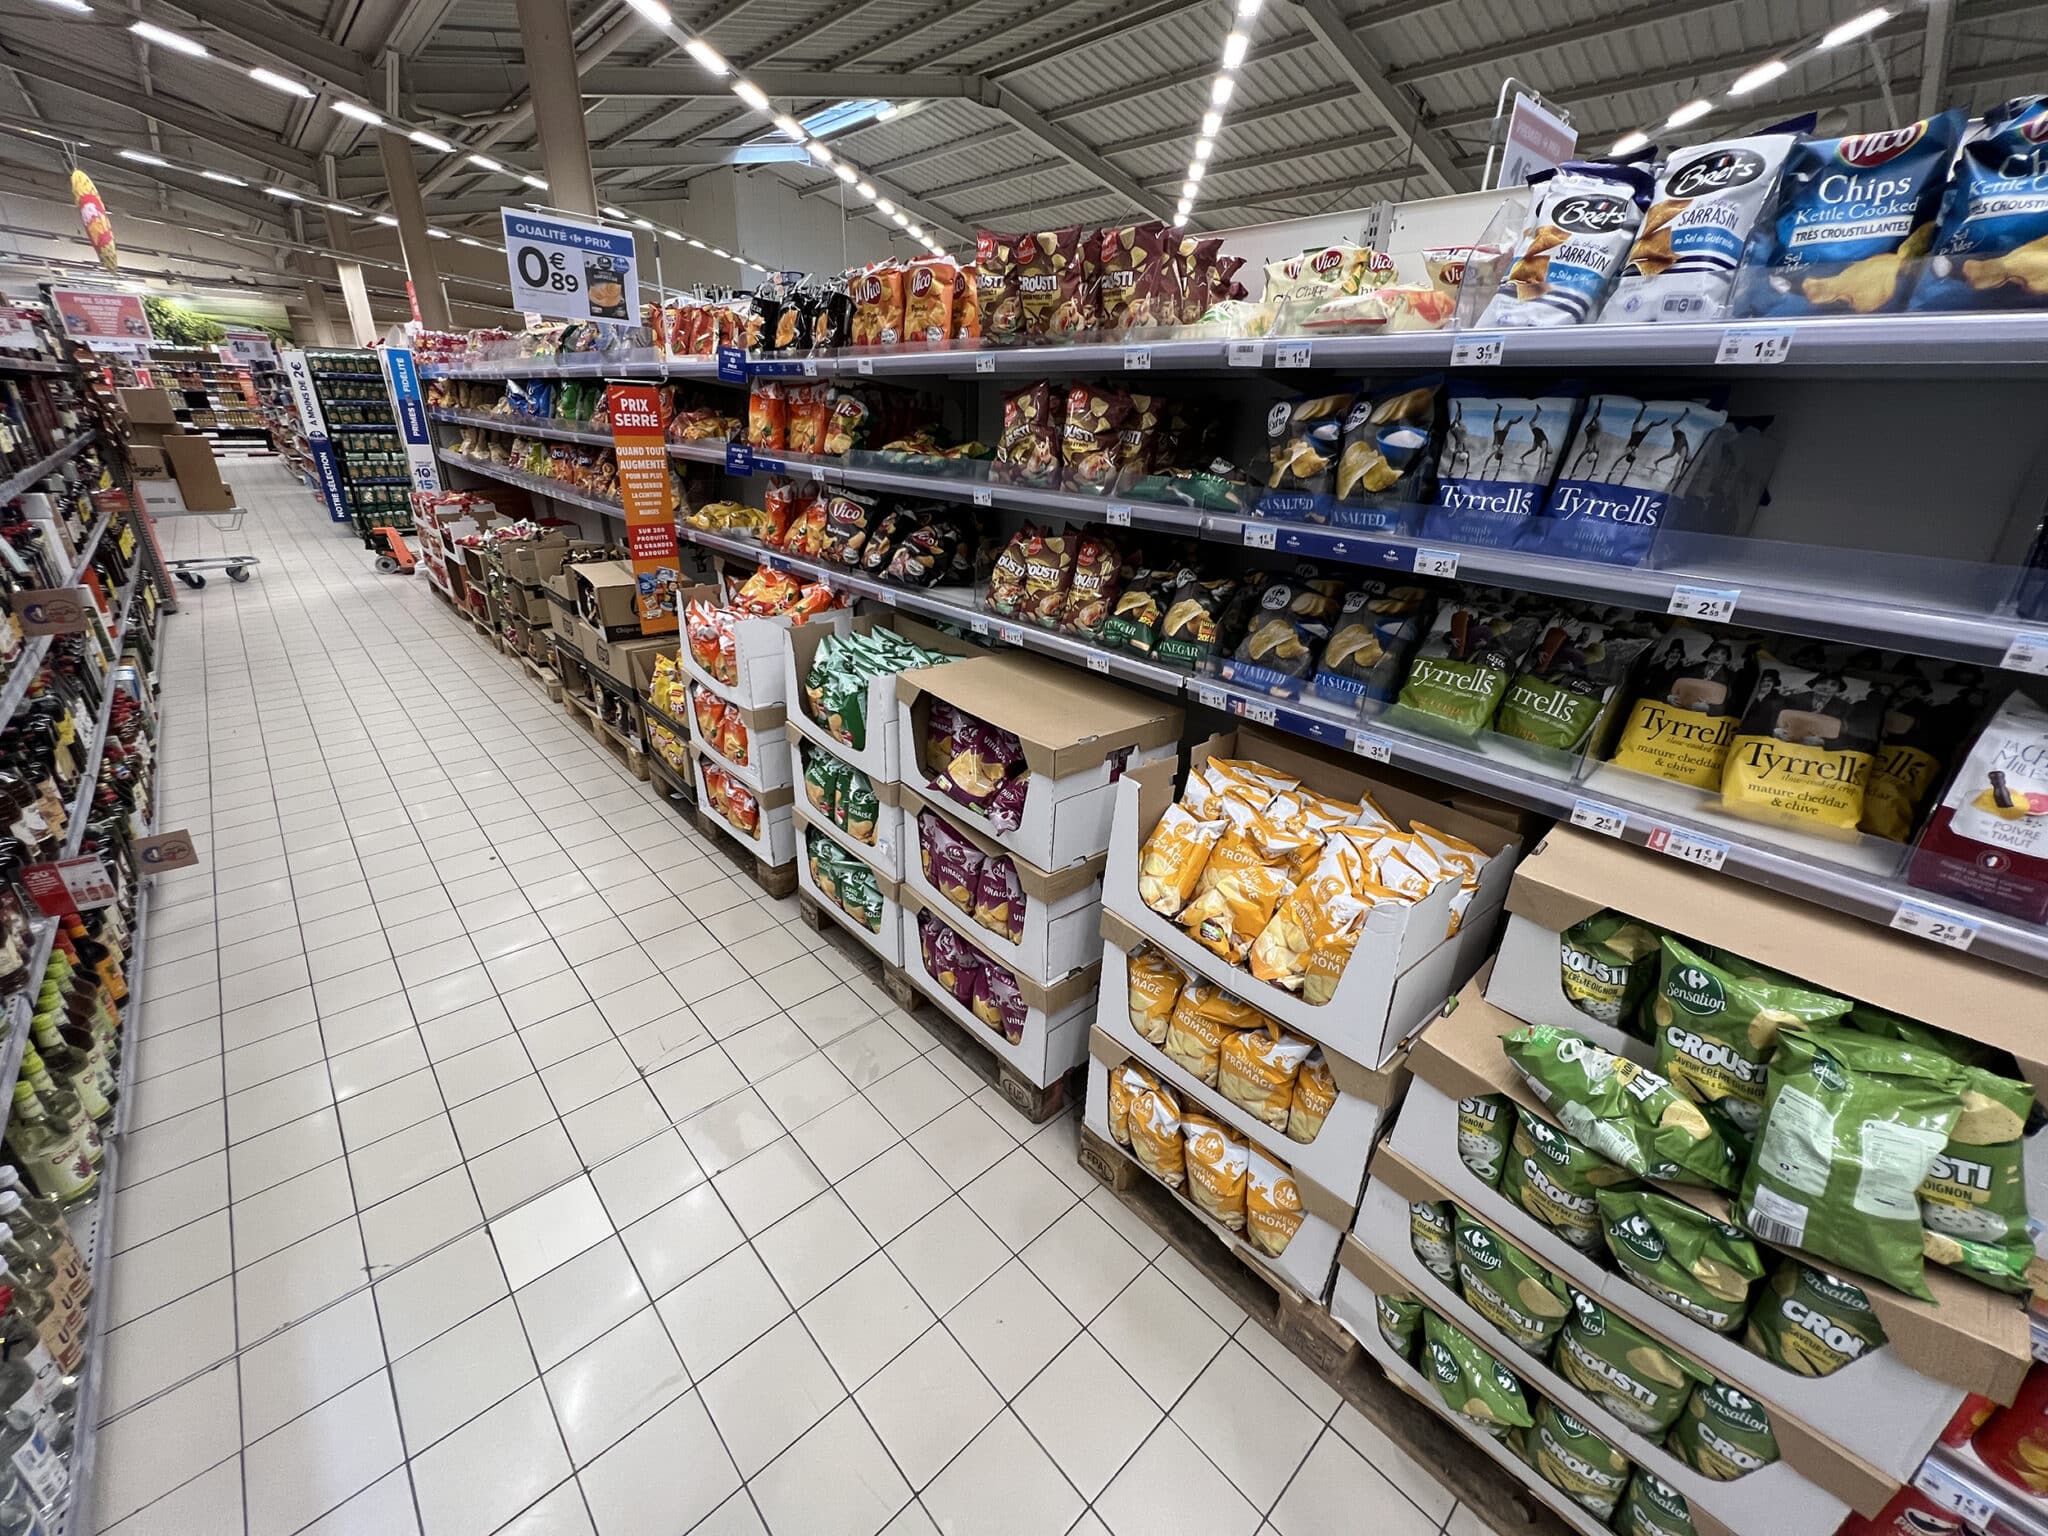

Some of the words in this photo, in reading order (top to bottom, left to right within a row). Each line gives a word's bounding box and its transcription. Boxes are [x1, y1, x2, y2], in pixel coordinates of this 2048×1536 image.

[1848, 125, 1915, 162] Vico
[1999, 148, 2048, 180] Ch
[1673, 156, 1754, 196] Brets
[1969, 177, 2028, 197] Kettle
[1818, 174, 1912, 206] Chips
[1557, 200, 1628, 230] Brets
[1678, 205, 1739, 230] SARRASIN
[1796, 207, 1847, 225] Kettle
[1849, 197, 1918, 218] Cooked
[515, 222, 568, 242] QUALITÉ
[584, 236, 612, 250] PRIX
[1795, 225, 1819, 242] TRÈS
[1821, 221, 1910, 240] CROUSTILLANTES
[1315, 255, 1340, 273] Vico
[1556, 244, 1612, 273] SARRASIN
[863, 279, 881, 302] Vico
[911, 269, 932, 294] Vico
[1018, 274, 1057, 291] CROUSTI
[299, 379, 308, 391] DE
[301, 392, 316, 420] MOINS
[620, 398, 649, 412] PRIX
[615, 411, 659, 427] SERRÉ
[616, 446, 645, 456] QUAND
[645, 446, 666, 456] TOUT
[620, 459, 666, 470] AUGMENTE
[831, 501, 861, 521] Vico
[1273, 497, 1314, 511] SALTED
[1341, 511, 1386, 527] SALTED
[636, 534, 669, 542] PRODUITS
[643, 541, 674, 550] GRANDES
[638, 549, 670, 558] MARQUES
[1026, 562, 1060, 581] OUSTI
[1158, 640, 1200, 660] VINEGAR
[1411, 658, 1497, 697] Tyrrells
[1512, 684, 1579, 724] rrells
[1636, 744, 1677, 759] mature
[1665, 760, 1697, 776] chive
[1744, 740, 1867, 787] Tyrrells
[1748, 782, 1795, 800] mature
[1796, 790, 1849, 811] cheddar
[1771, 797, 1782, 807] &
[1784, 801, 1820, 817] chive
[1991, 830, 2033, 849] TIMUT
[1992, 820, 2042, 840] POIVRE
[1312, 954, 1341, 974] ROM
[1560, 944, 1630, 985] ROUSTI
[1130, 975, 1162, 997] MAGE
[1666, 981, 1728, 1012] Sensation
[1666, 1026, 1769, 1084] CROUST
[1460, 1115, 1485, 1130] IGNON
[1523, 1158, 1600, 1214] CROUS
[1921, 1180, 1974, 1202] OIGNON
[1250, 1210, 1295, 1236] FROMA
[1460, 1262, 1545, 1334] CROUSTI
[1562, 1323, 1659, 1407] CROUSTI
[1700, 1388, 1769, 1435] Sensation
